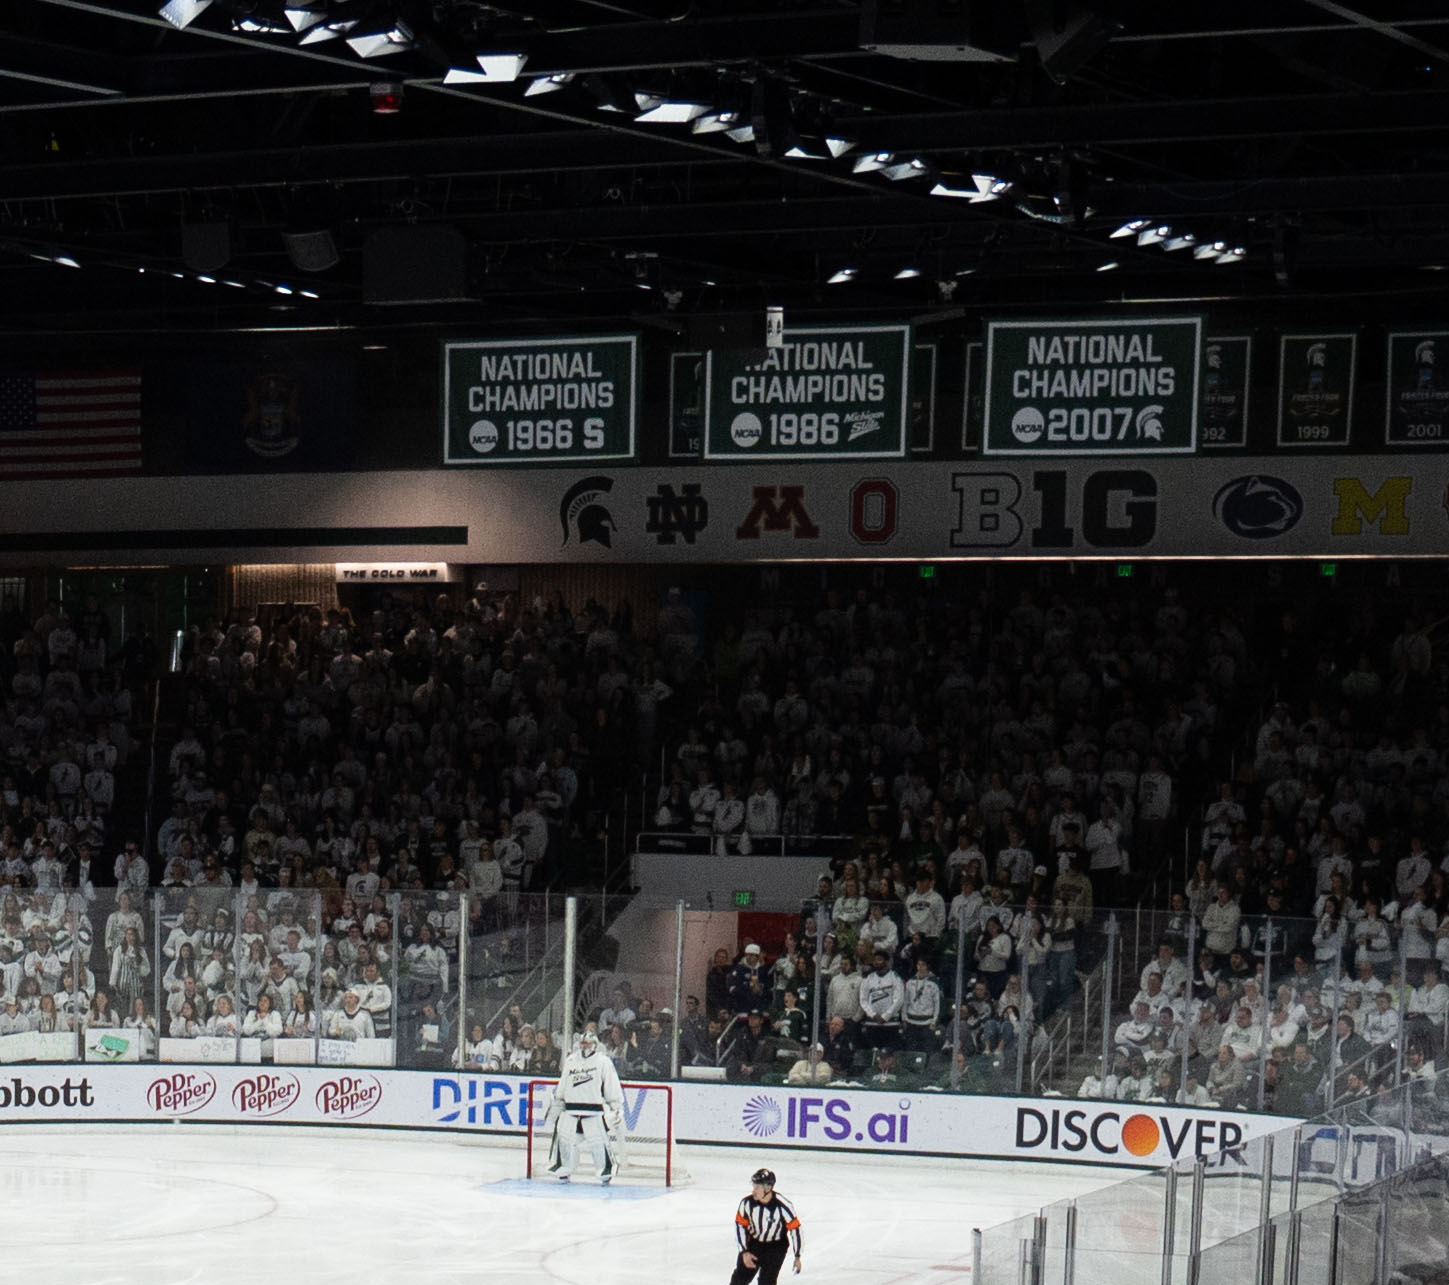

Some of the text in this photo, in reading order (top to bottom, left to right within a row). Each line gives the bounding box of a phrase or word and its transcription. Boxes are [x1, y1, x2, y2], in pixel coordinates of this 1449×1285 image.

[744, 342, 873, 371] ATIONAL
[1027, 333, 1162, 364] NATIONAL
[480, 351, 602, 381] NATIONAL
[468, 382, 614, 412] CHAMPIONS
[730, 373, 885, 404] CHAMPIONS
[1012, 368, 1176, 398] CHAMPIONS
[507, 418, 605, 450] 1966 S
[769, 413, 840, 445] 1986
[1047, 408, 1132, 441] 2007
[1297, 426, 1329, 440] 1999
[1407, 424, 1442, 436] 2001
[736, 485, 820, 539] M
[849, 477, 900, 546] O
[1331, 475, 1412, 536] M
[343, 568, 438, 579] THE COLD WAR
[154, 1078, 212, 1111] Pepper
[171, 1073, 196, 1091] Dr
[238, 1080, 296, 1112] Pepper
[256, 1074, 280, 1092] Dr
[339, 1077, 363, 1094] Dr
[322, 1082, 378, 1114] Pepper
[787, 1096, 912, 1143] IFS.ai
[1016, 1107, 1247, 1168] DISCOVER
